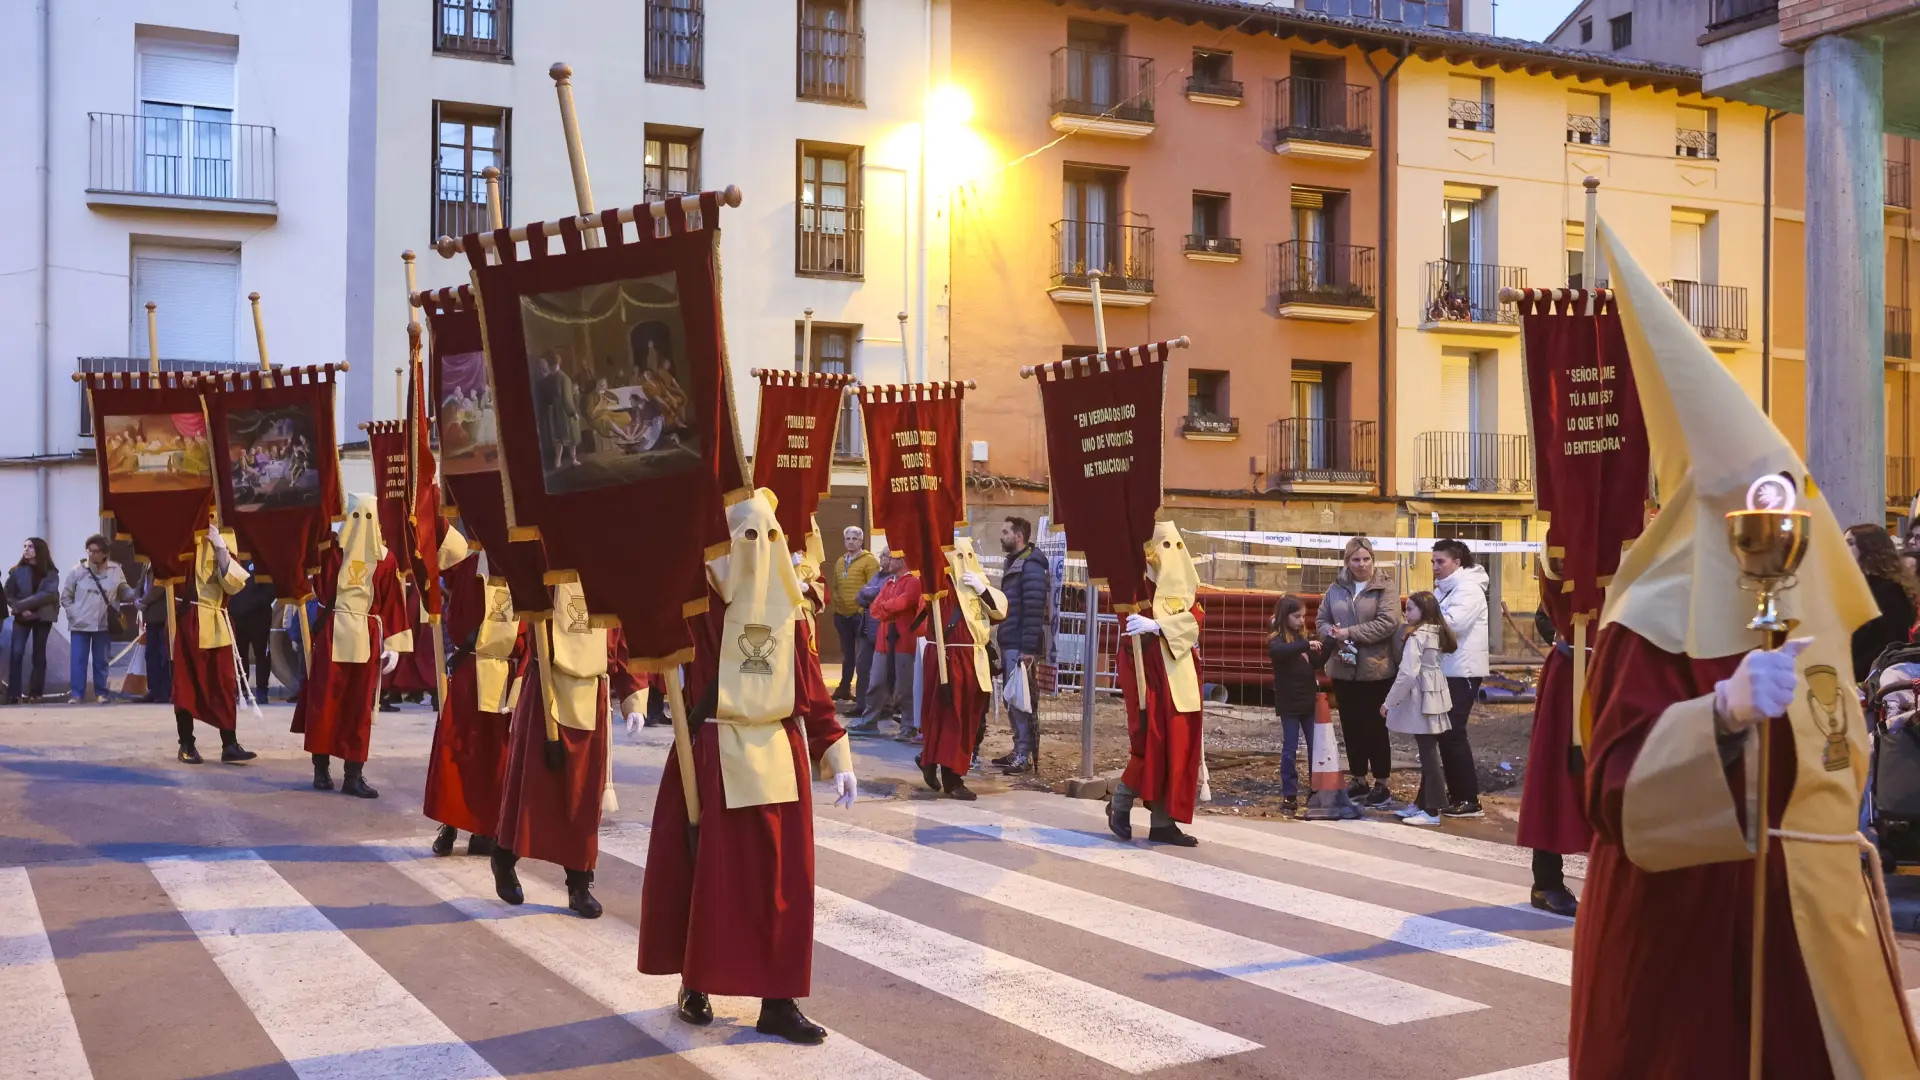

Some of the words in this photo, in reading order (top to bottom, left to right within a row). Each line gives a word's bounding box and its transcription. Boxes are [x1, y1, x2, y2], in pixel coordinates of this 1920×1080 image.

[1569, 390, 1580, 407] TÚ
[1581, 393, 1587, 406] A
[1588, 392, 1599, 406] MI
[1567, 417, 1576, 431] LO
[1578, 416, 1594, 431] QUE
[1605, 413, 1619, 427] NO
[1081, 437, 1096, 453] UNO
[1096, 434, 1105, 450] DE
[1564, 442, 1572, 455] LO
[902, 452, 923, 469] TODOS
[1084, 463, 1094, 478] ME
[891, 477, 909, 492] ESTE
[909, 476, 919, 491] ES
